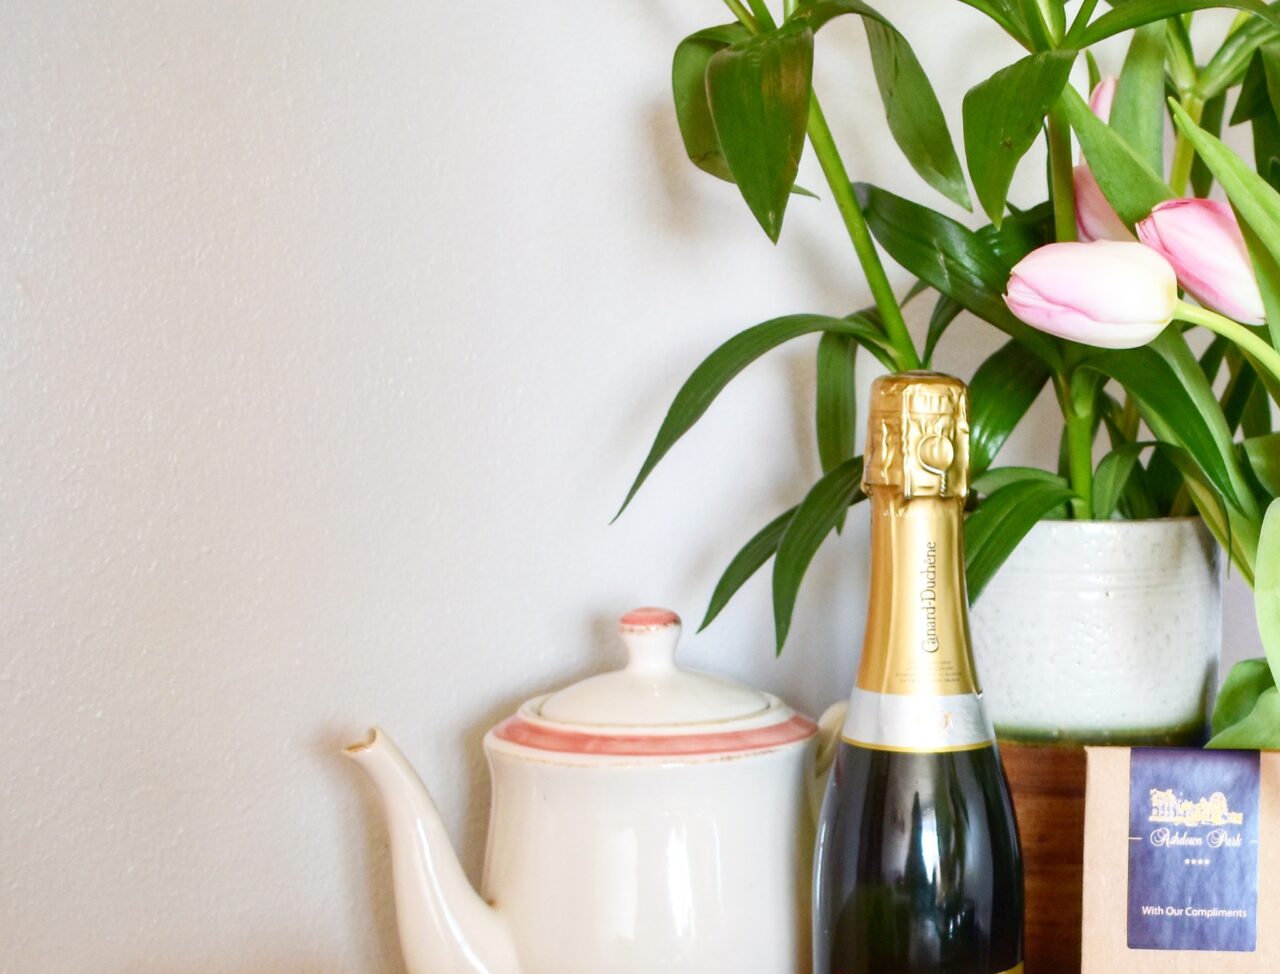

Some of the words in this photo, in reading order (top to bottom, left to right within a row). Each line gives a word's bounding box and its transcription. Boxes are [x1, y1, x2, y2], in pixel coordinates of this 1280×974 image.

[921, 541, 939, 654] Canard-Duchêne
[1150, 828, 1203, 848] Ashdown
[1206, 828, 1243, 849] Park
[1141, 905, 1164, 916] With
[1166, 905, 1183, 917] Our
[1185, 905, 1248, 919] Compliments
